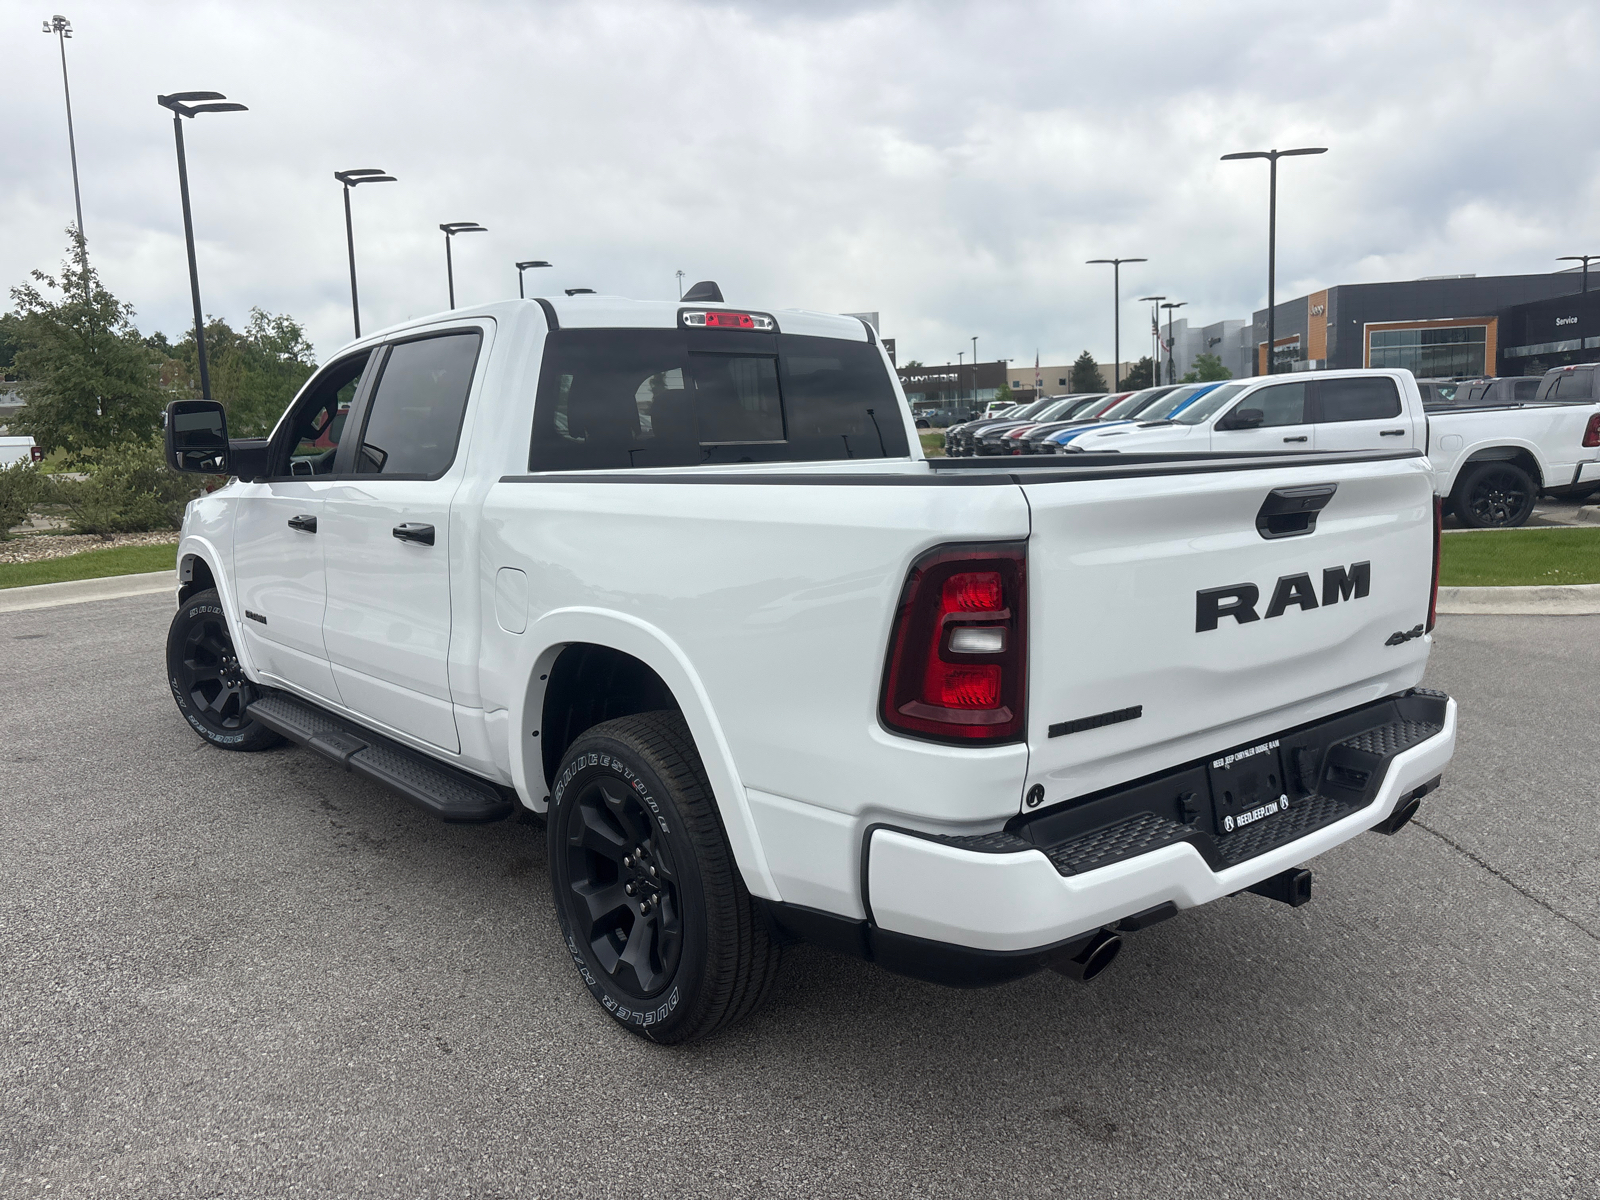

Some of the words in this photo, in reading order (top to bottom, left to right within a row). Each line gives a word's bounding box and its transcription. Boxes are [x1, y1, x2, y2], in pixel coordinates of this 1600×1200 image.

[1311, 305, 1324, 316] Jeep
[1556, 316, 1578, 326] Service
[1195, 560, 1371, 633] RAM
[1384, 623, 1424, 646] 4x4
[188, 714, 245, 743] DUELER
[1212, 758, 1225, 769] REED
[1224, 754, 1235, 765] JEEP
[1234, 747, 1255, 761] CHRYSLER
[1255, 742, 1269, 754] DODGE
[1268, 739, 1280, 749] RAM
[555, 753, 670, 834] BRIDGESTONE
[1236, 801, 1279, 827] REEDJEEP.COM
[602, 986, 680, 1027] DUELER
